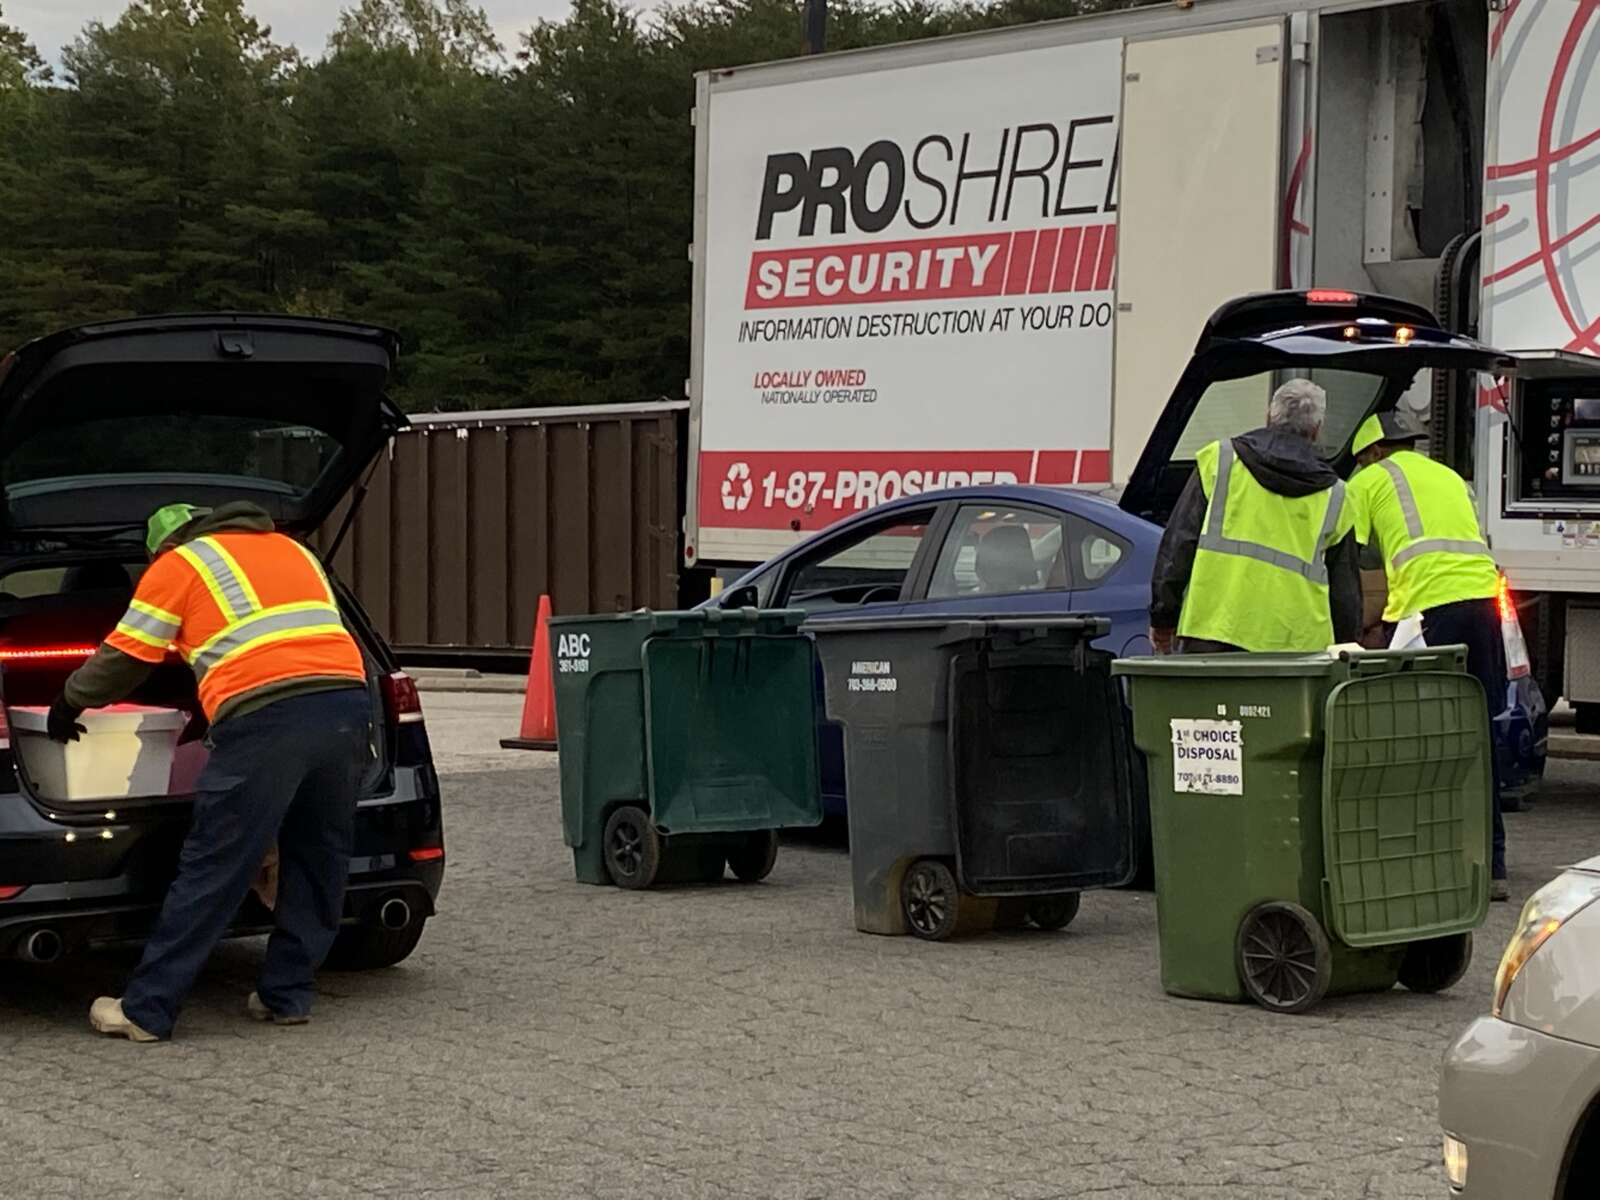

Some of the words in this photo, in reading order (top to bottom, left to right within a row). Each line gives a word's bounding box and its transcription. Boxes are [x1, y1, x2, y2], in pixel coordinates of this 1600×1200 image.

[755, 243, 1001, 300] SECURITY
[738, 315, 852, 343] INFORMATION
[856, 309, 986, 339] DESTRUCTION
[989, 307, 1014, 332] AT
[1020, 304, 1073, 332] YOUR
[754, 370, 812, 389] LOCALLY
[815, 369, 867, 388] OWNED
[761, 390, 822, 405] NATIONALLY
[823, 389, 877, 404] OPERATED
[557, 633, 591, 658] ABC
[851, 661, 891, 674] AMERICAN
[1193, 730, 1238, 743] CHOICE
[1177, 747, 1238, 761] DISPOSAL
